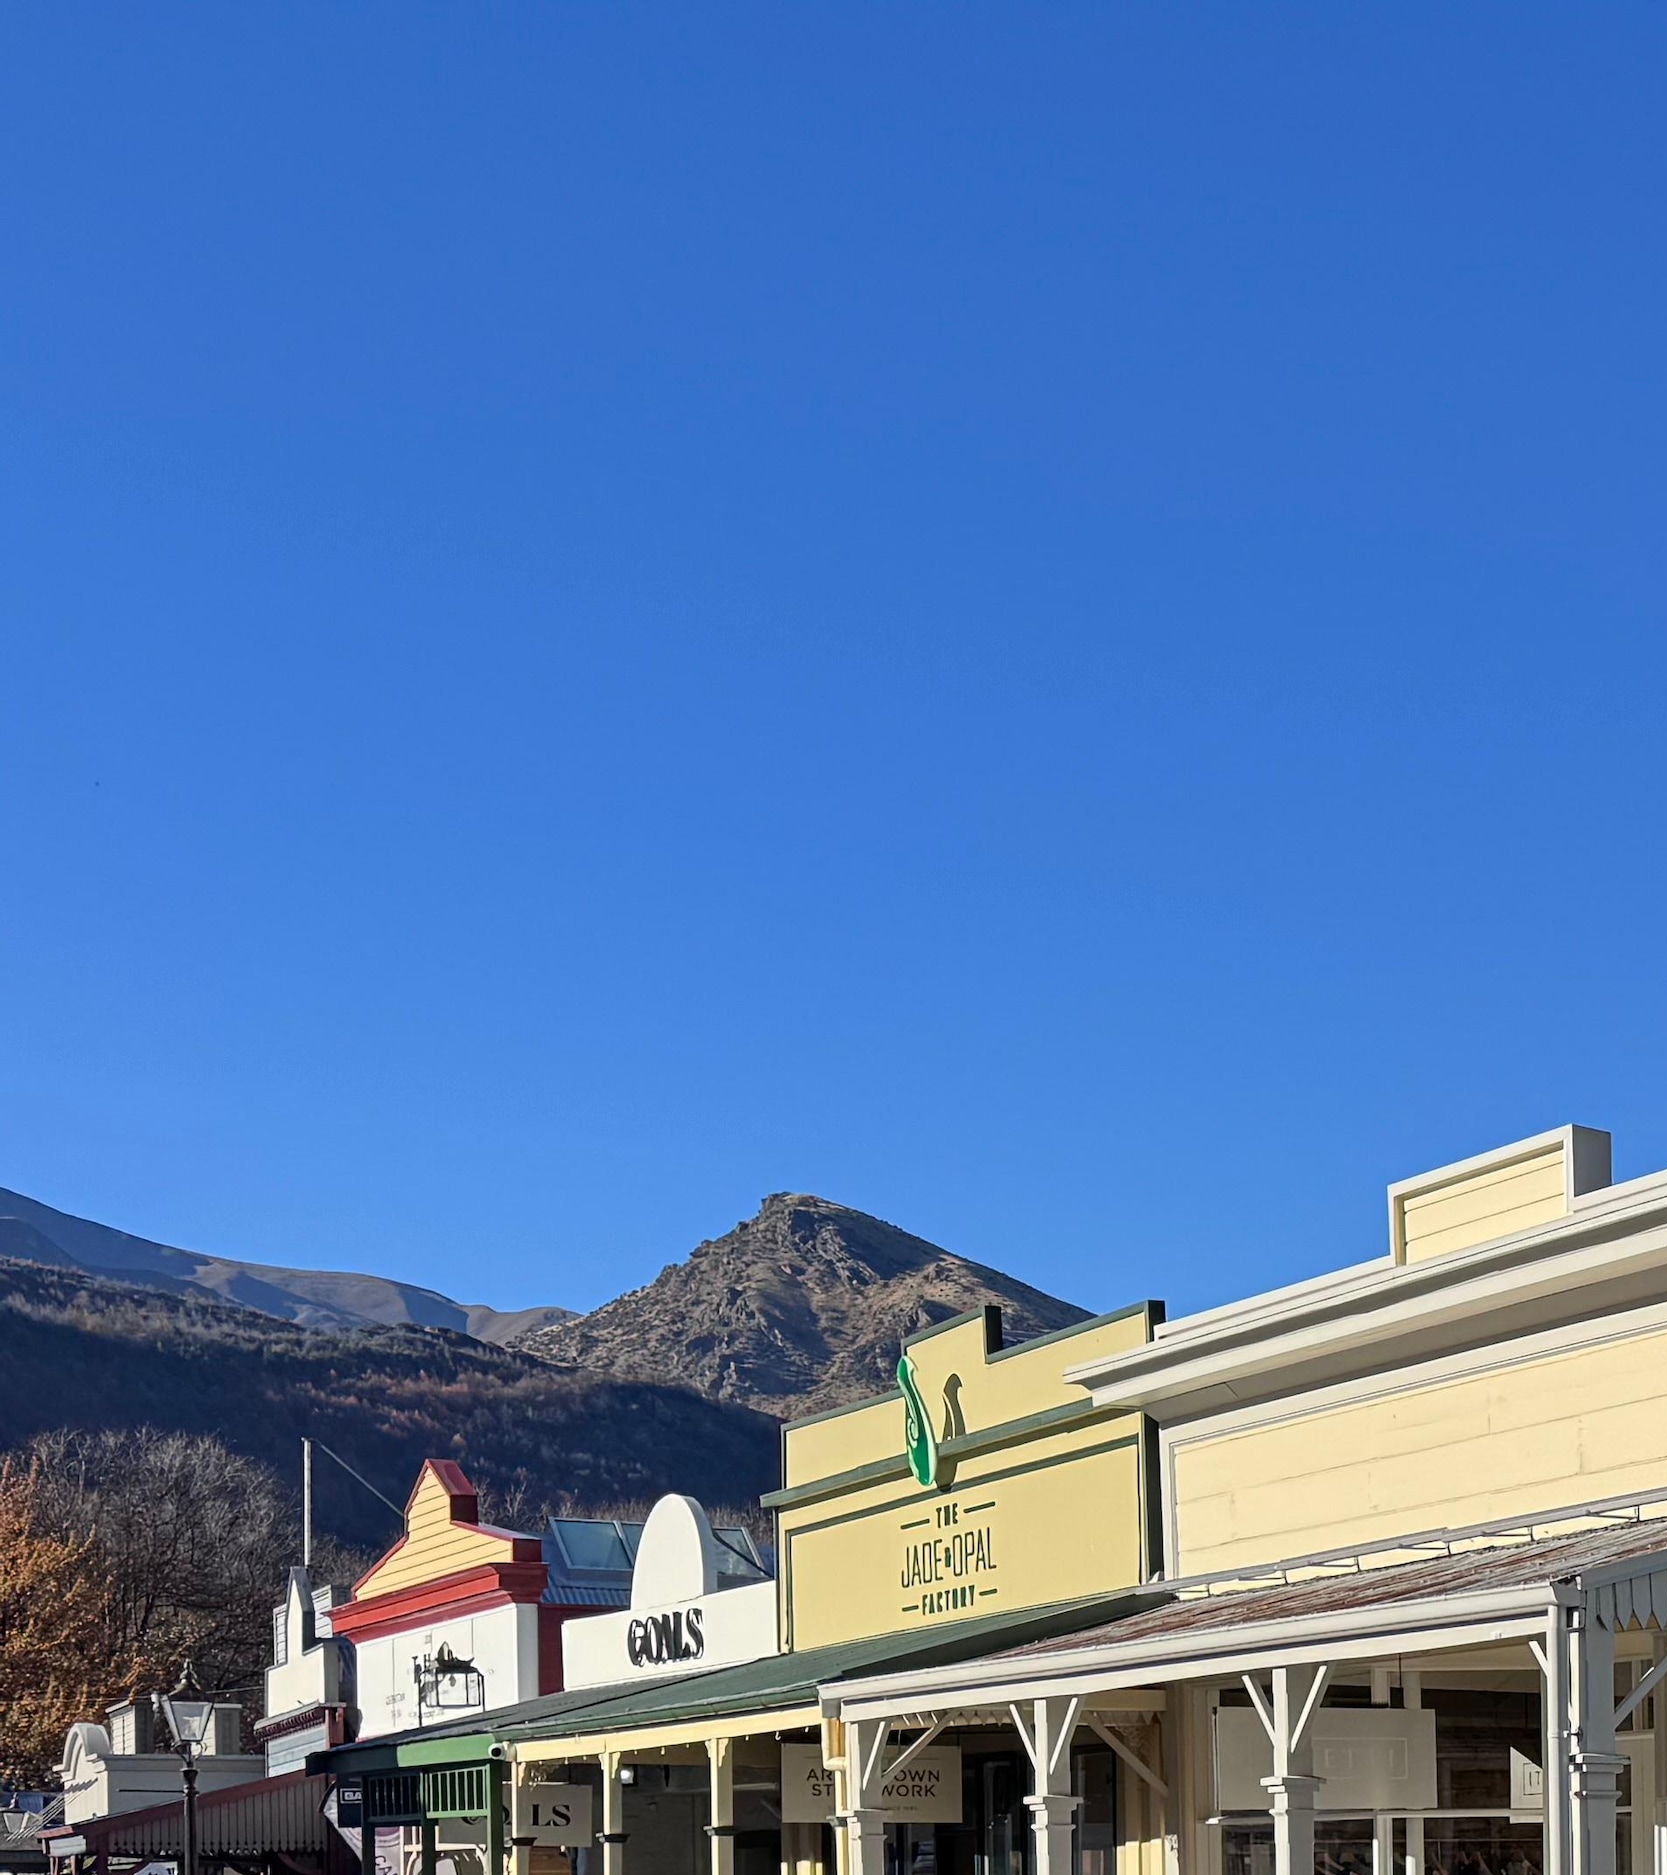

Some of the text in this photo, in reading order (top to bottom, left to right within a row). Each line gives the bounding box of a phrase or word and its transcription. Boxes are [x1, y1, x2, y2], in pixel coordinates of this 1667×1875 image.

[936, 1502, 958, 1529] THE
[901, 1538, 944, 1588] JADE
[952, 1526, 997, 1577] OPAL
[922, 1584, 975, 1616] FACTORY
